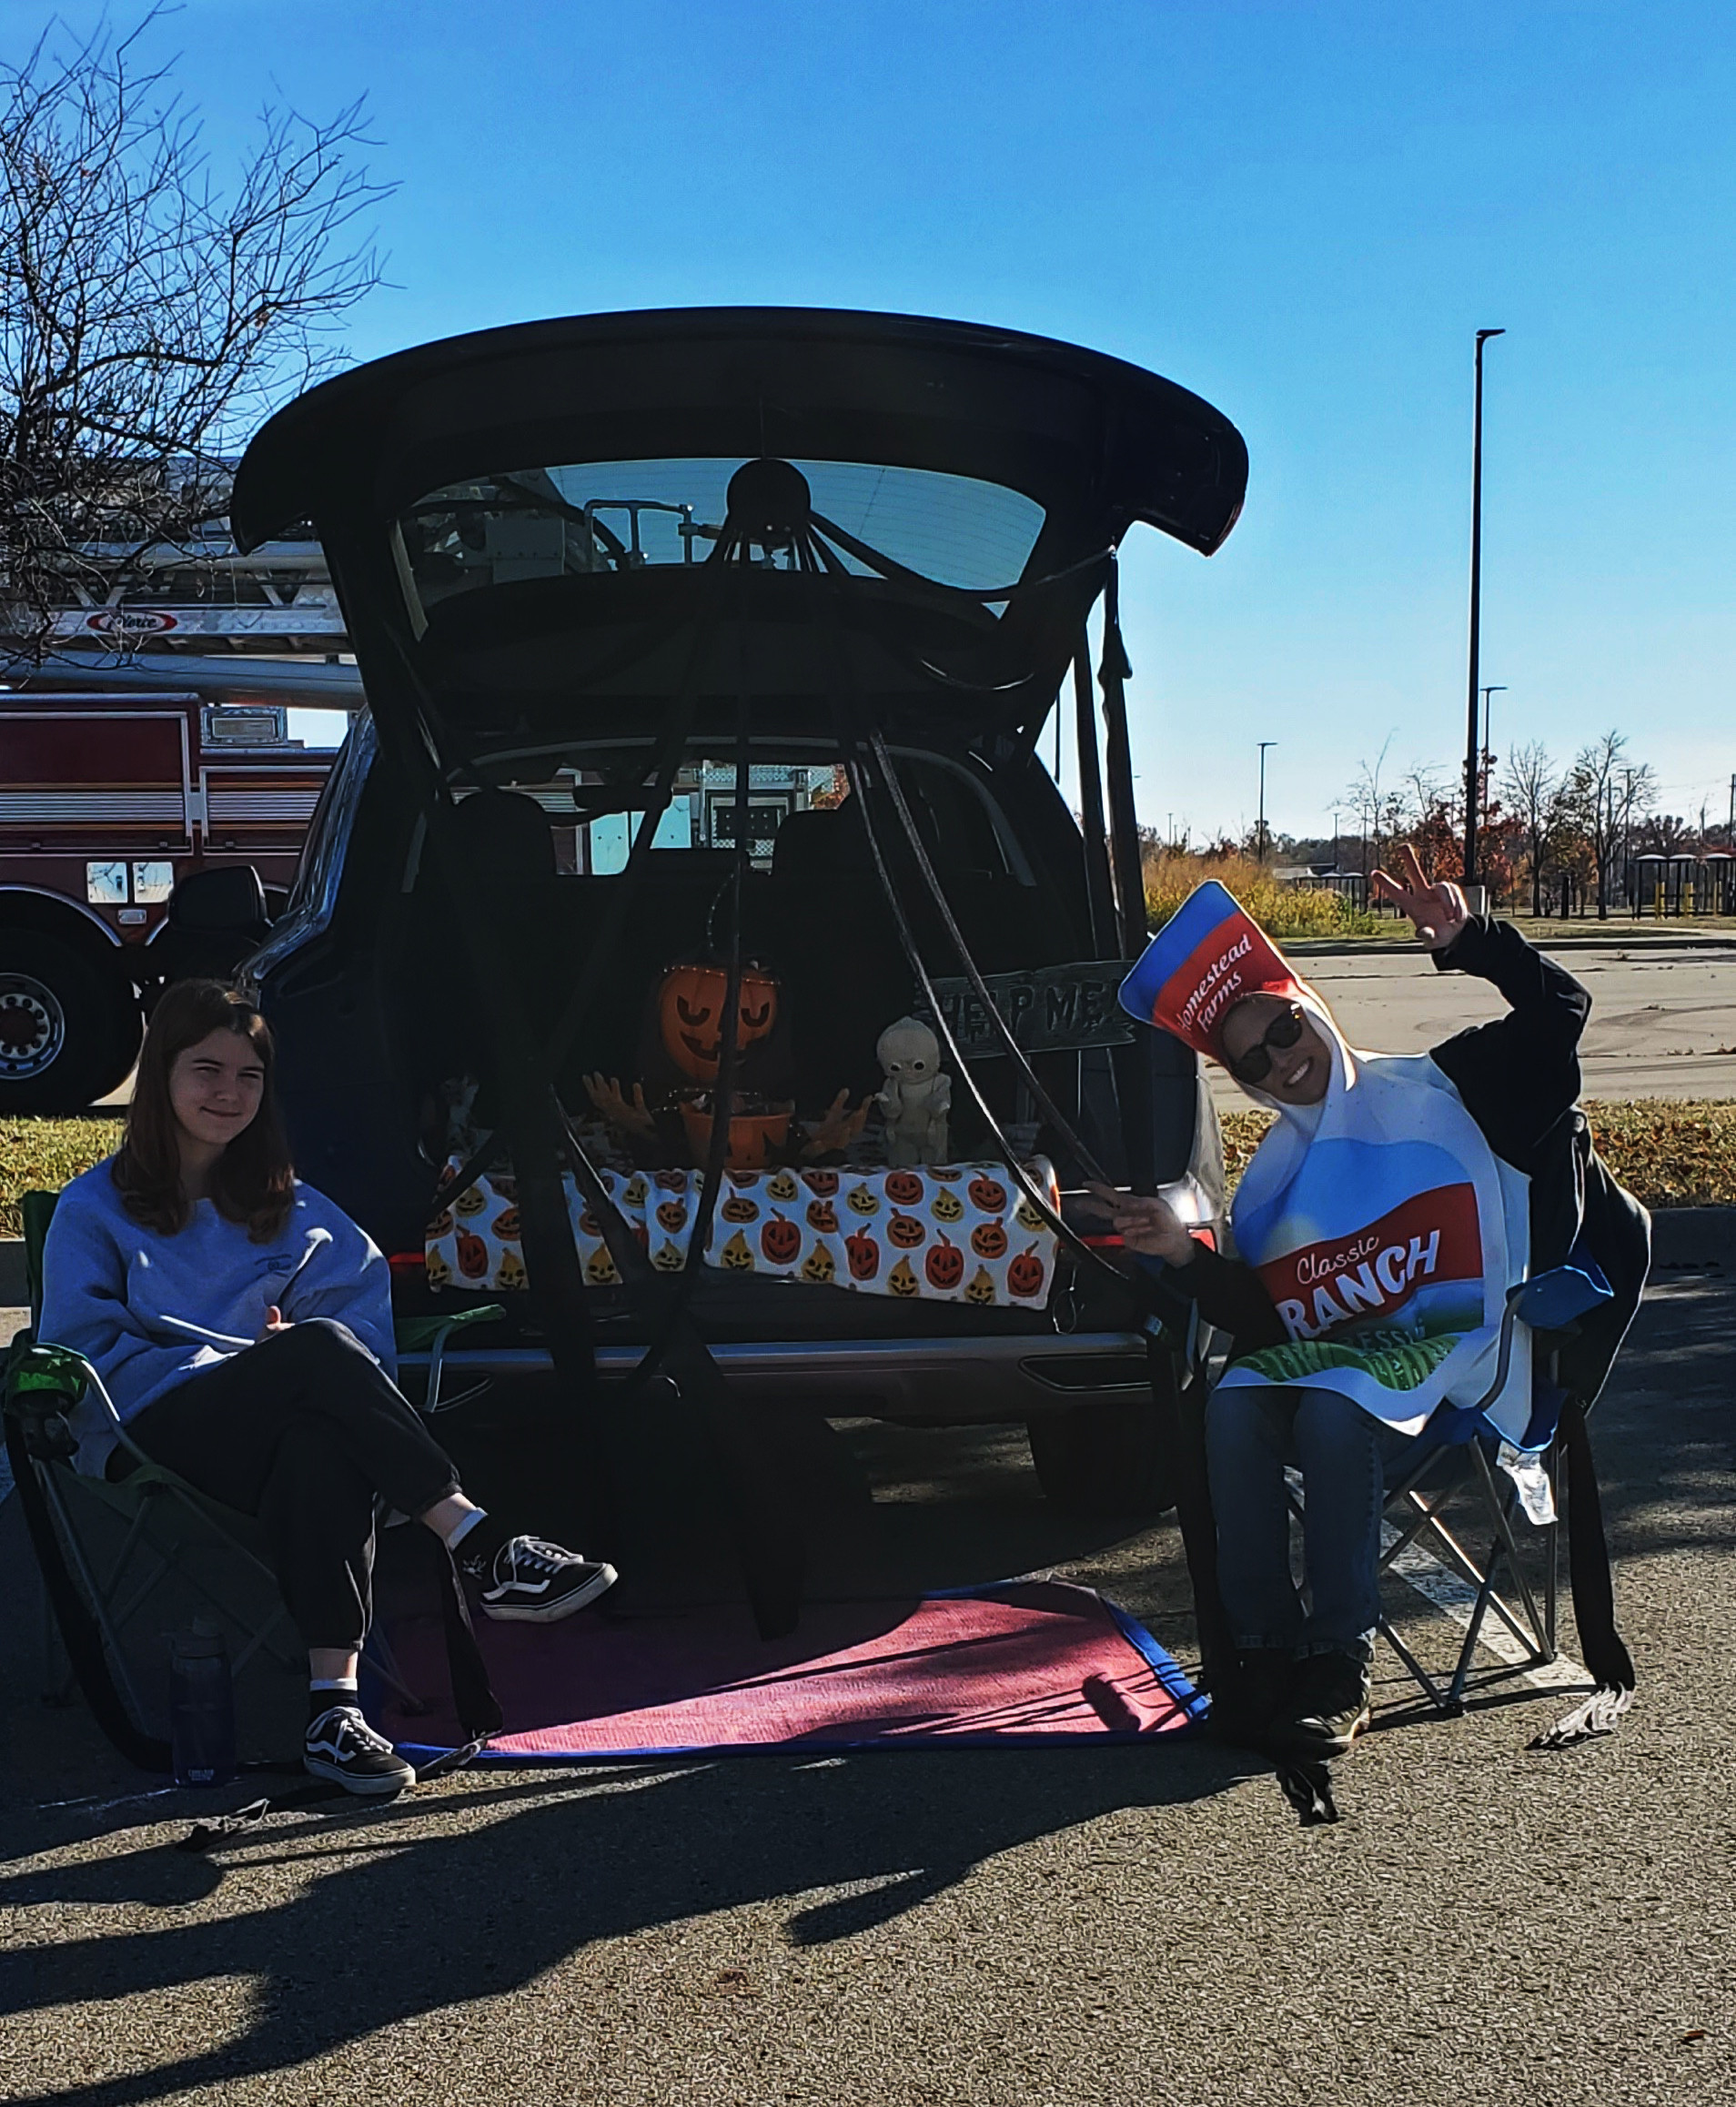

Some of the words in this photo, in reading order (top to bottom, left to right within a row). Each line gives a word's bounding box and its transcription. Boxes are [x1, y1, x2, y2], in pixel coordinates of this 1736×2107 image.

[1176, 933, 1253, 1032] Homestead
[1196, 971, 1242, 1033] Farms
[1275, 1229, 1440, 1343] RANCH
[1297, 1236, 1379, 1285] Classic
